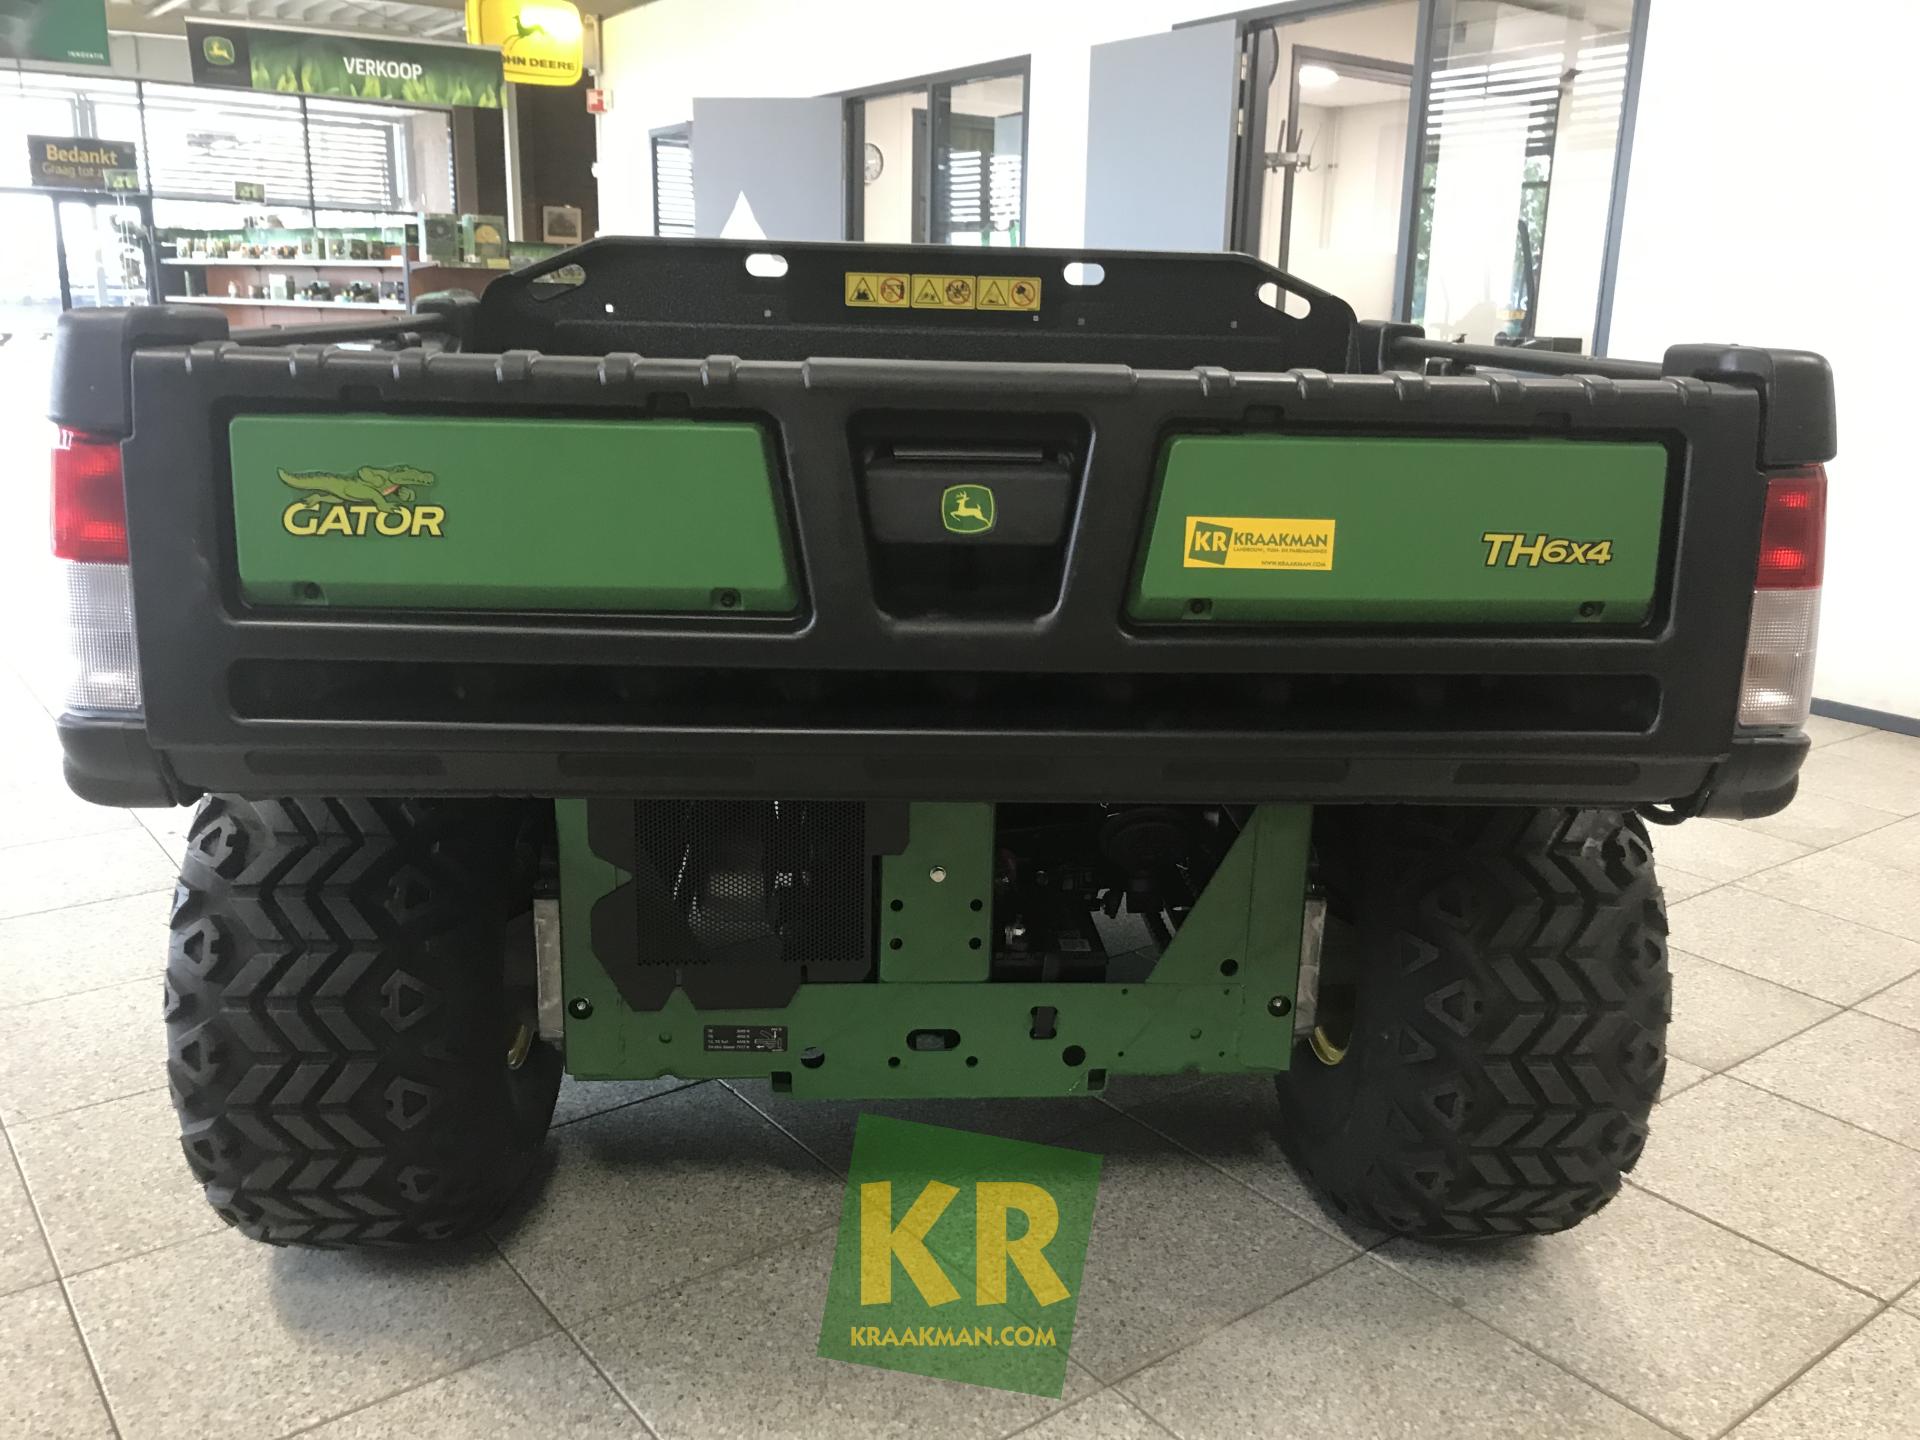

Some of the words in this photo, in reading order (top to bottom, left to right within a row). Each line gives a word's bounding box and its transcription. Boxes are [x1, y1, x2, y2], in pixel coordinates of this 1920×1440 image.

[343, 56, 422, 80] VERKOOP
[529, 57, 575, 70] DEERE
[46, 143, 118, 166] Bedankt
[42, 161, 75, 178] Graag
[282, 501, 446, 537] GATOR
[1195, 531, 1227, 552] KR
[1233, 532, 1328, 547] KRAAKMAN
[1482, 532, 1613, 567] TH6x4
